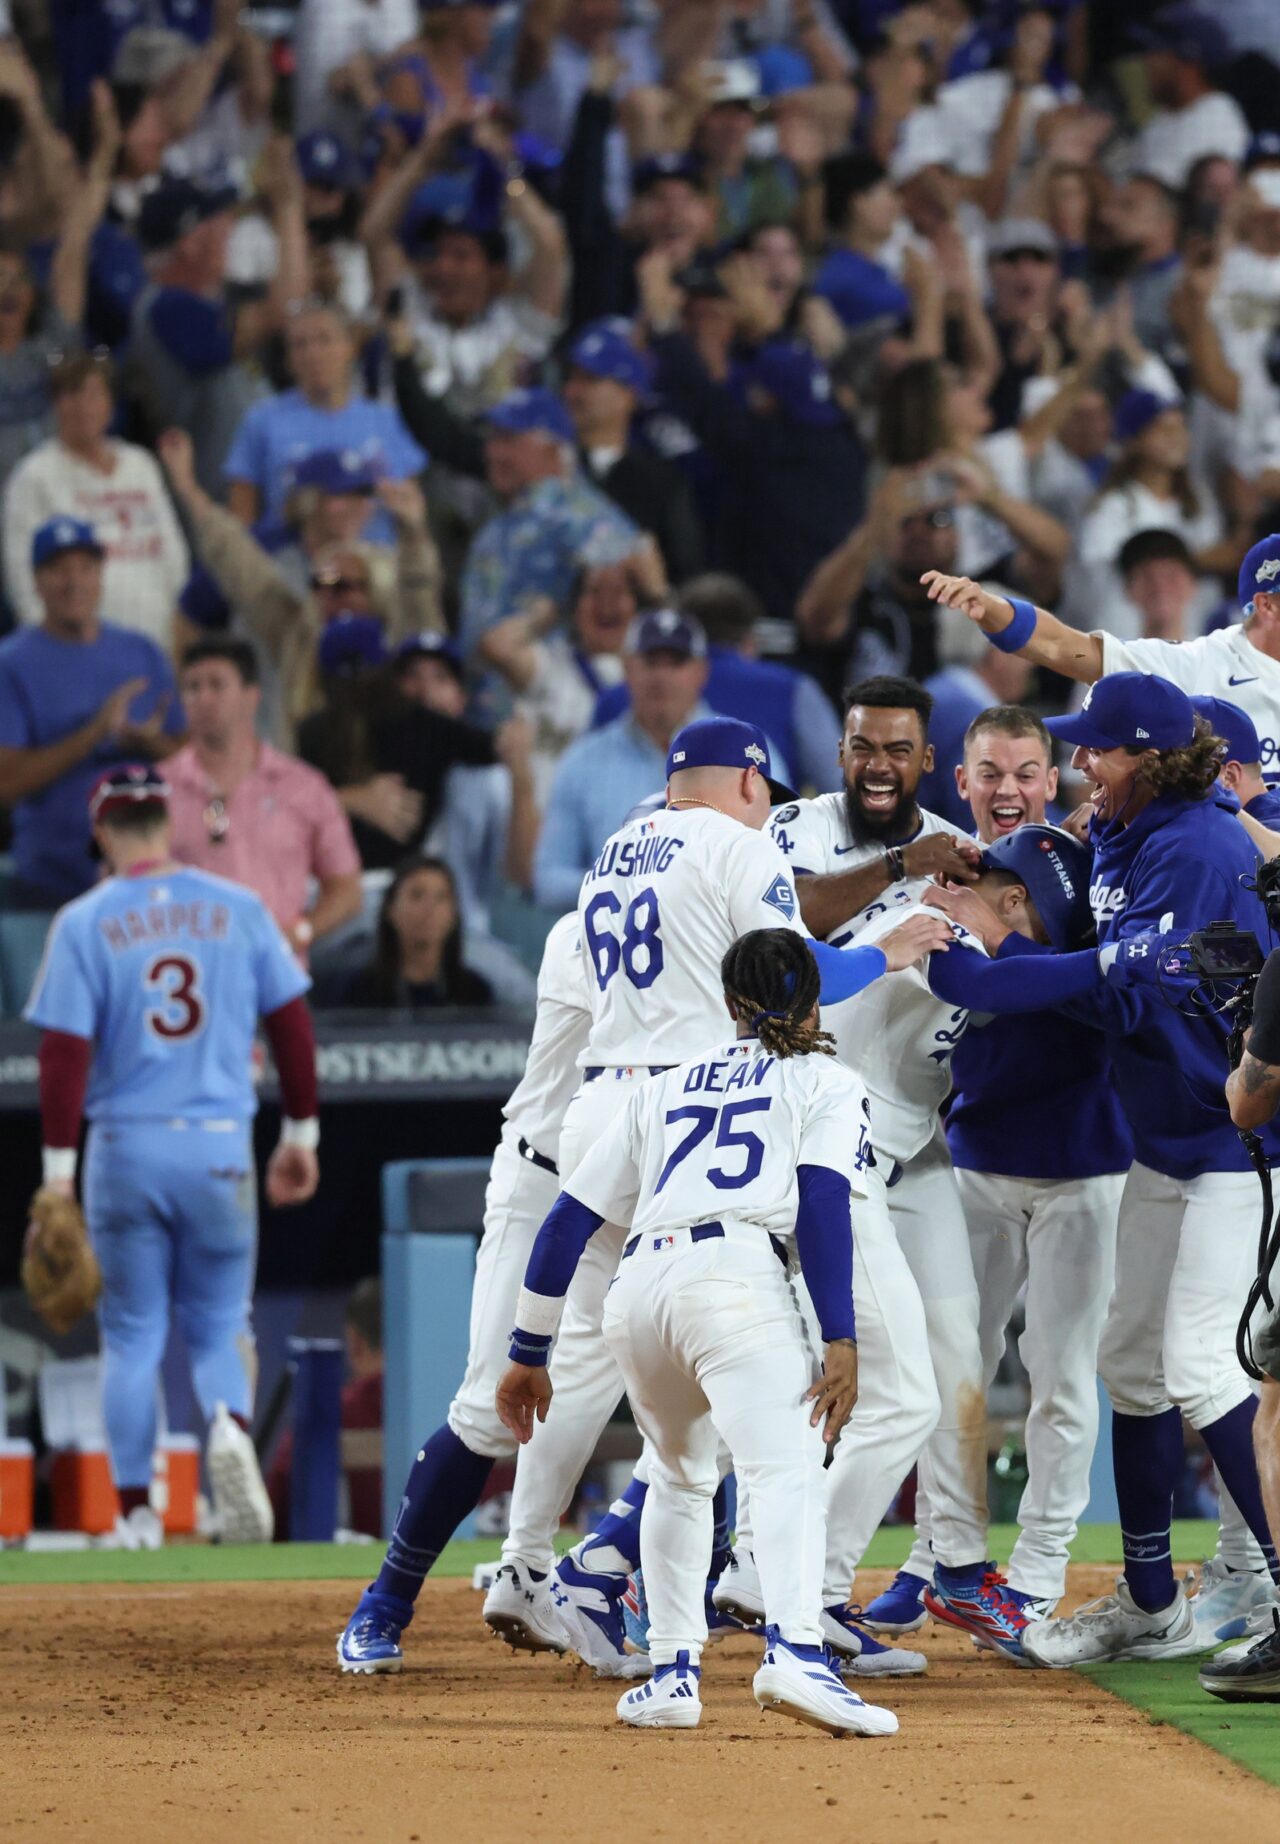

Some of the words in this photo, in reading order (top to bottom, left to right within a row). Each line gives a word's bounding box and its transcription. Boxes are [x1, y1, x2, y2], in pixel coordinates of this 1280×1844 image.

[1047, 850, 1076, 900] STRAUSS
[101, 902, 230, 955] HARPER
[584, 886, 664, 992] 68
[148, 954, 204, 1041] 3
[683, 1057, 776, 1094] DEAN
[653, 1096, 773, 1197] 75
